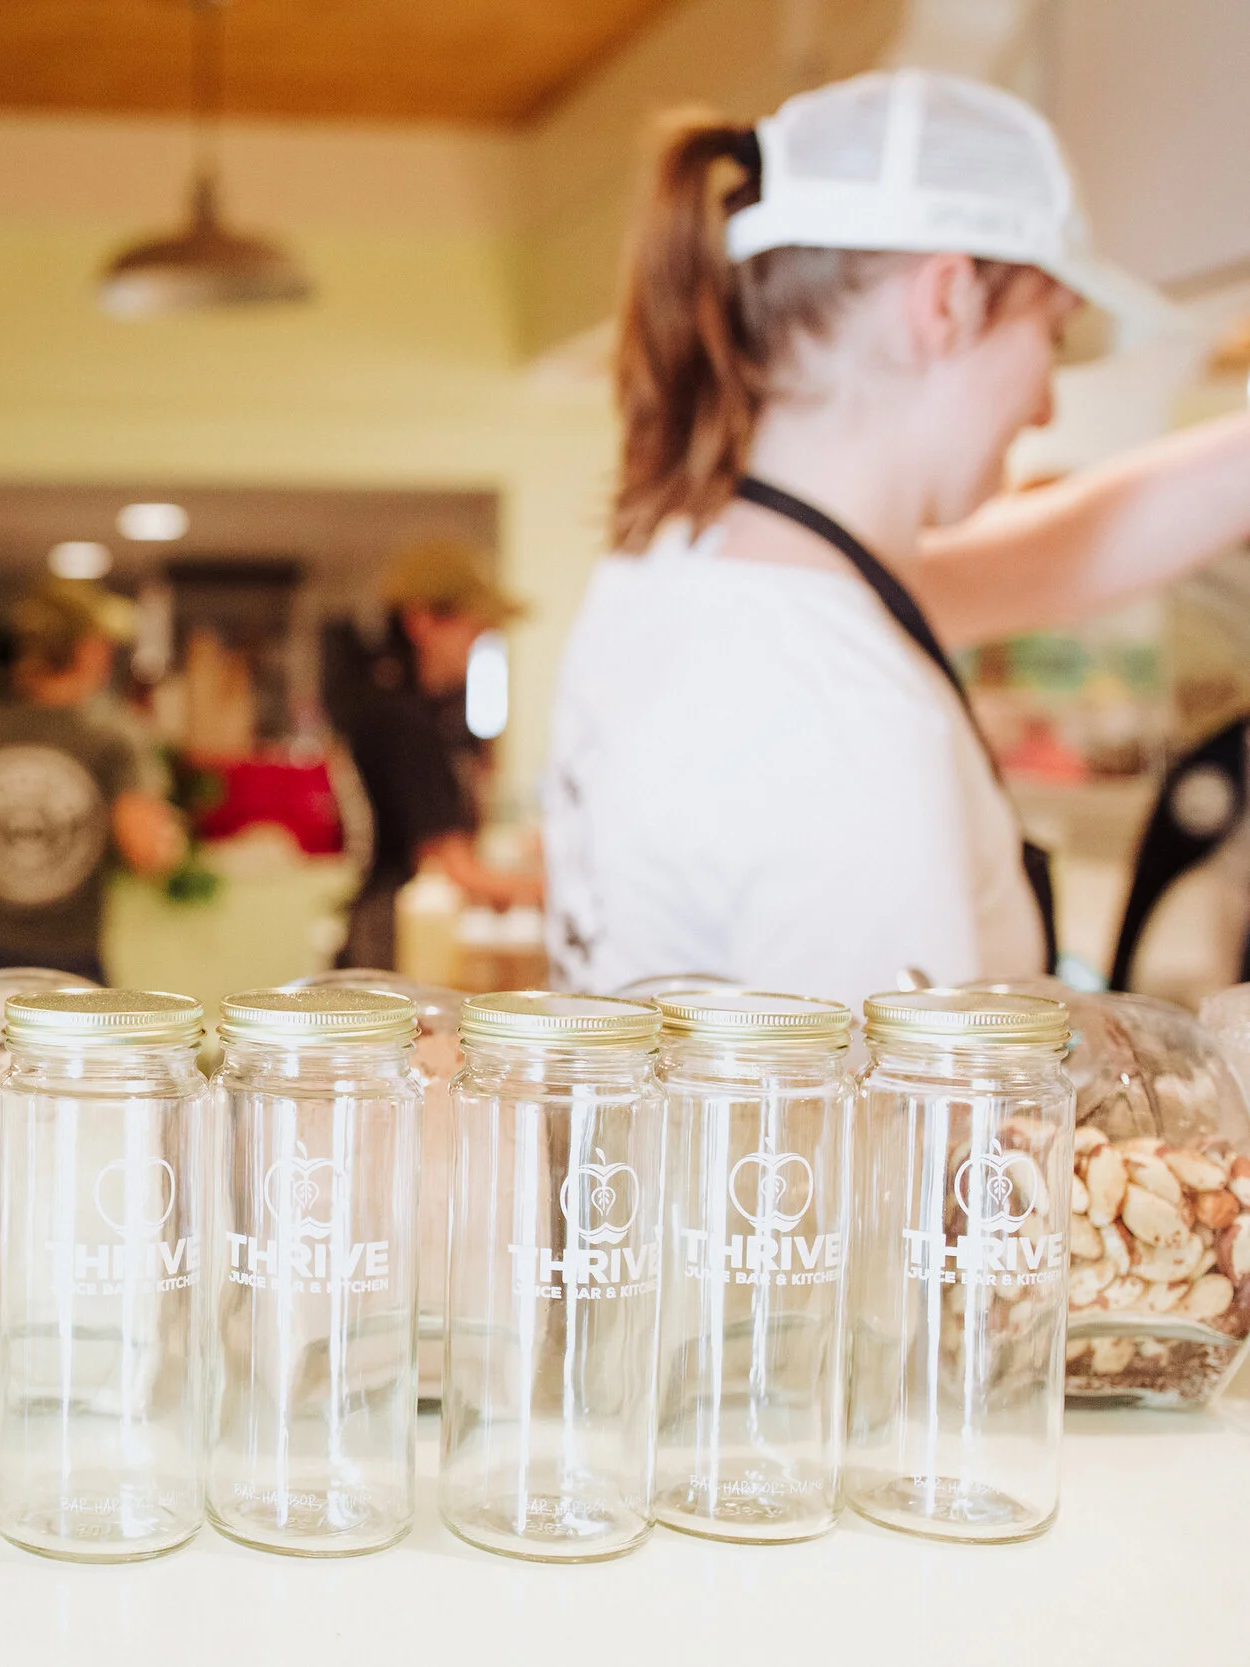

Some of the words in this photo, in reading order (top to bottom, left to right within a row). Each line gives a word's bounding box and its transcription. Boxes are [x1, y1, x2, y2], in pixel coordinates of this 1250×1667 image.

[736, 1272, 771, 1285] BAR
[776, 1273, 787, 1285] &
[1002, 1273, 1013, 1286] &
[310, 1281, 322, 1294] &
[606, 1286, 617, 1299] &
